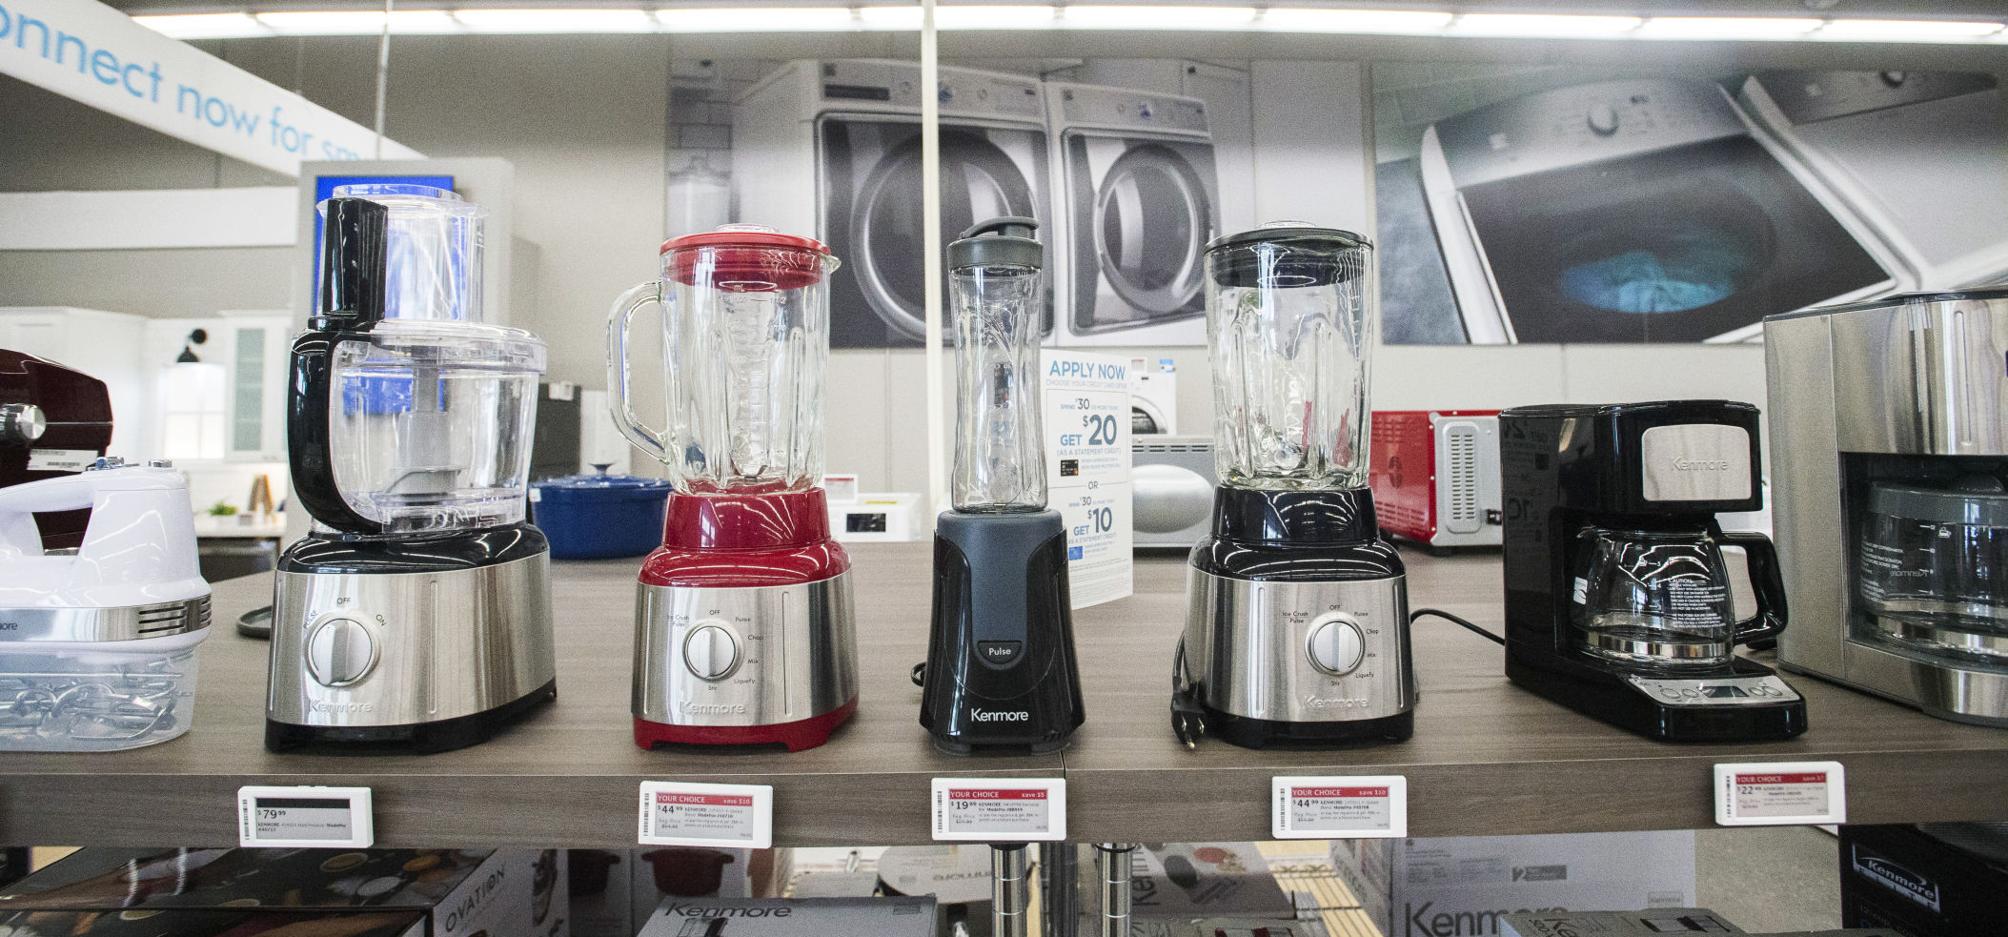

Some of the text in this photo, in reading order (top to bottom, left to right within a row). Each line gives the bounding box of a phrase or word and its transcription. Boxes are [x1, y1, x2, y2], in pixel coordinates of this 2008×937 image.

[177, 83, 260, 135] now
[269, 106, 315, 156] for
[1049, 359, 1126, 380] APPLY NOW
[1060, 414, 1117, 446] GET $20
[1671, 455, 1729, 471] Kenmore
[1087, 480, 1099, 490] OR
[1073, 506, 1112, 536] GET $10
[336, 597, 351, 605] OFF
[375, 614, 387, 627] ON
[988, 647, 1012, 656] Pulse
[308, 700, 374, 713] Kenmore
[679, 700, 746, 714] Kenmore
[1304, 695, 1369, 708] Kenmore
[970, 707, 1029, 722] Kenmore
[657, 795, 679, 803] YOUR
[679, 796, 705, 804] CHOICE
[1867, 859, 1935, 900] Kenmore
[445, 862, 506, 933] OVATION
[665, 902, 792, 918] Kenmore
